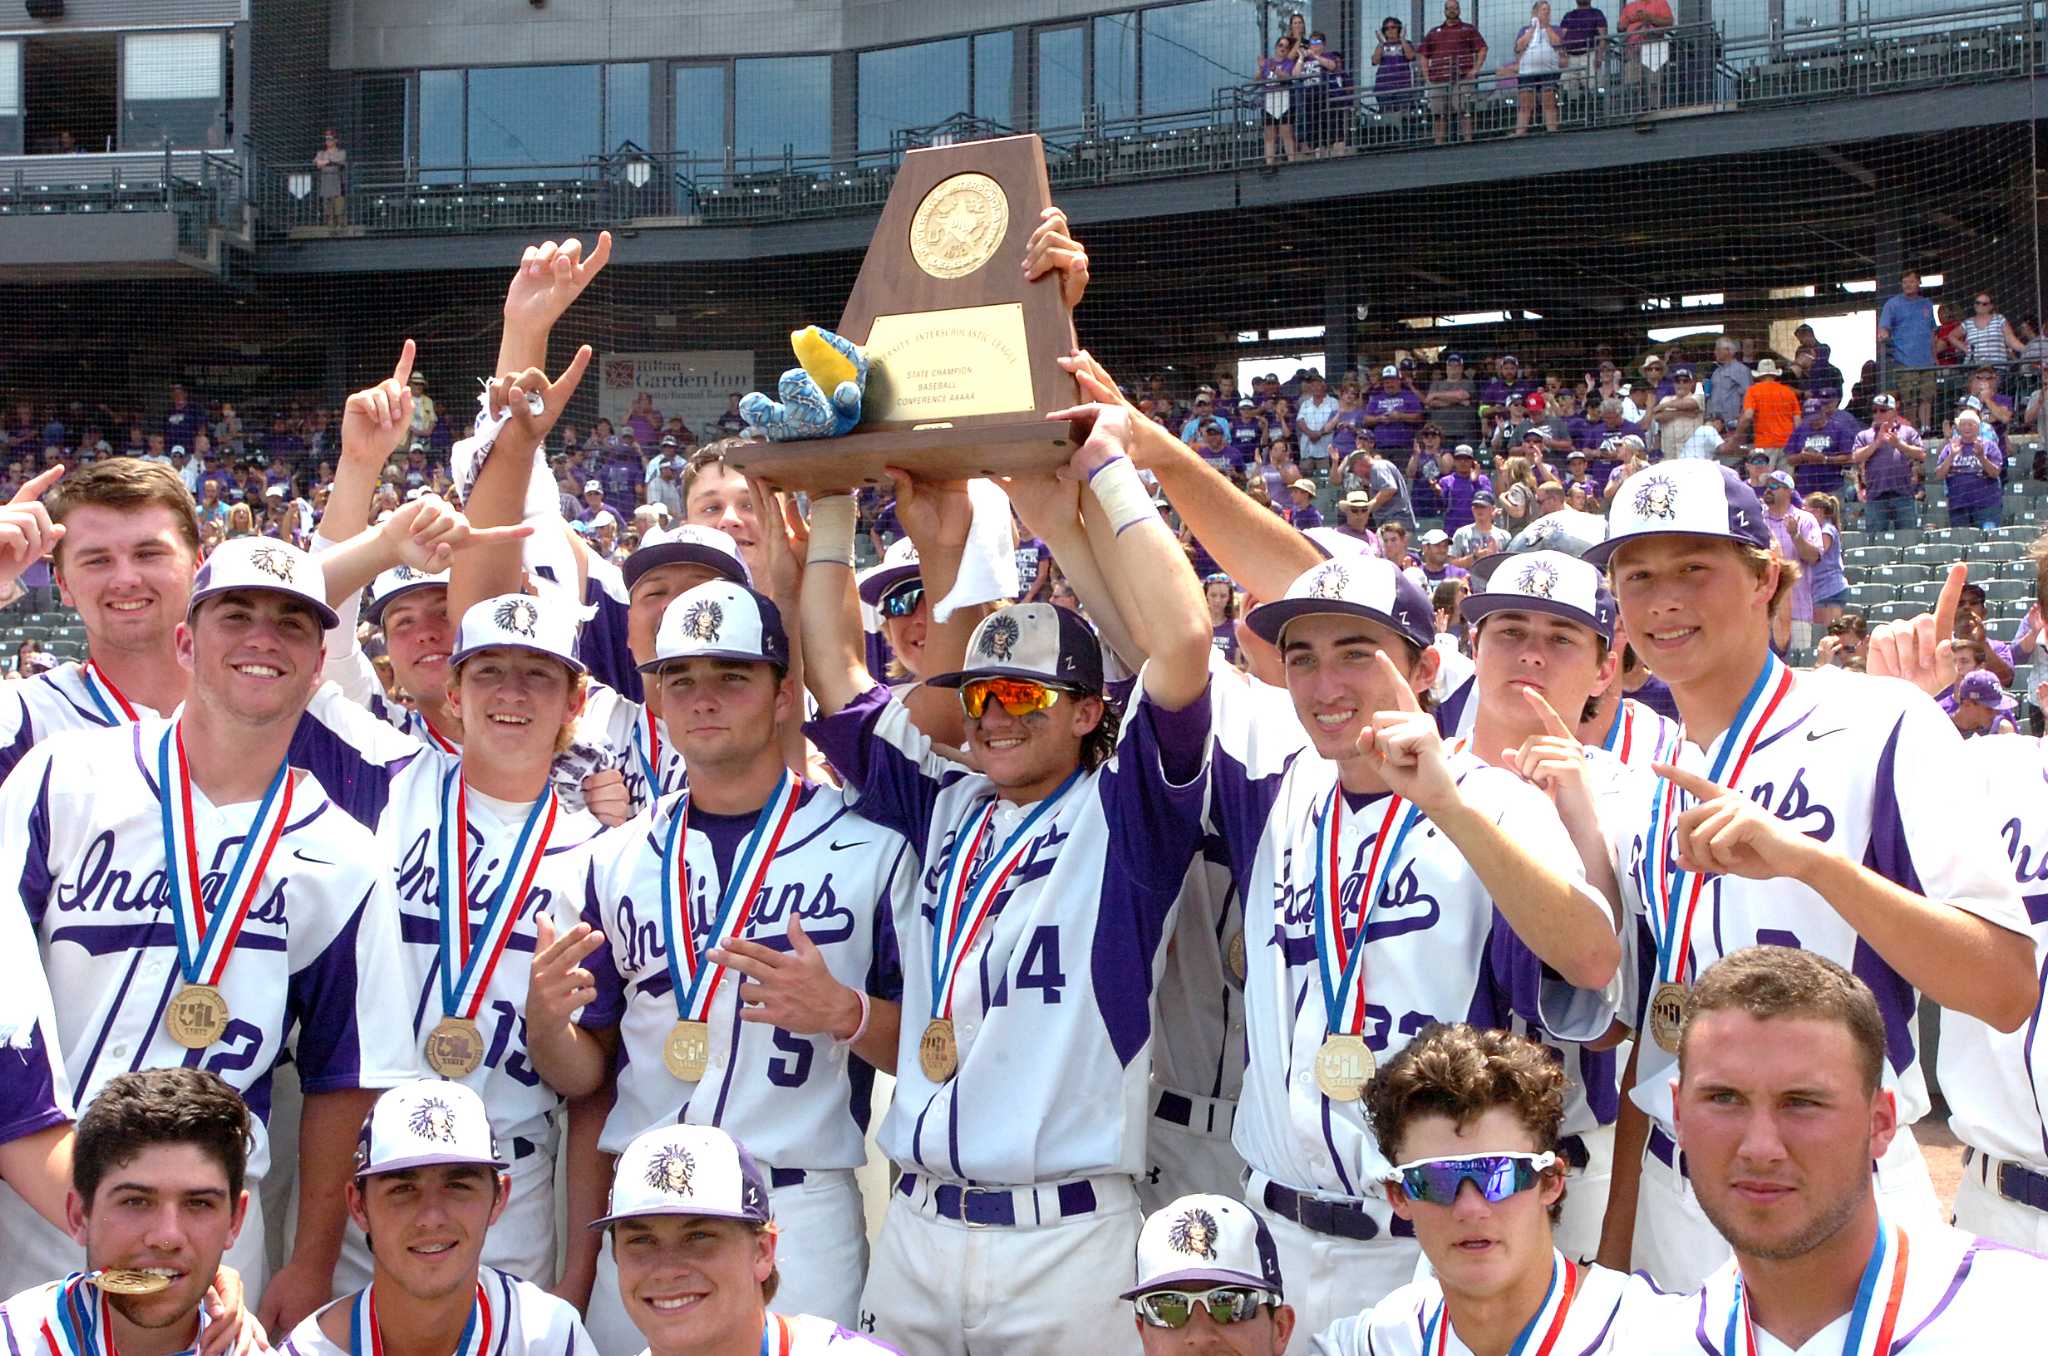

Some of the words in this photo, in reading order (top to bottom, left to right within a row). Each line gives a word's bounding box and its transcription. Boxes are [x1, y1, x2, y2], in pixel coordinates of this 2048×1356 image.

[636, 372, 708, 388] Garden
[713, 370, 747, 388] Inn
[906, 369, 929, 380] STATE
[931, 366, 974, 377] CHAMPION
[917, 381, 957, 392] BASEBALL
[897, 394, 946, 407] CONFERENCE
[1736, 509, 1750, 527] Z
[1398, 610, 1411, 626] Z
[1599, 609, 1608, 624] Z
[1065, 655, 1076, 671] Z
[766, 1026, 815, 1089] 5
[747, 1186, 758, 1205] Z
